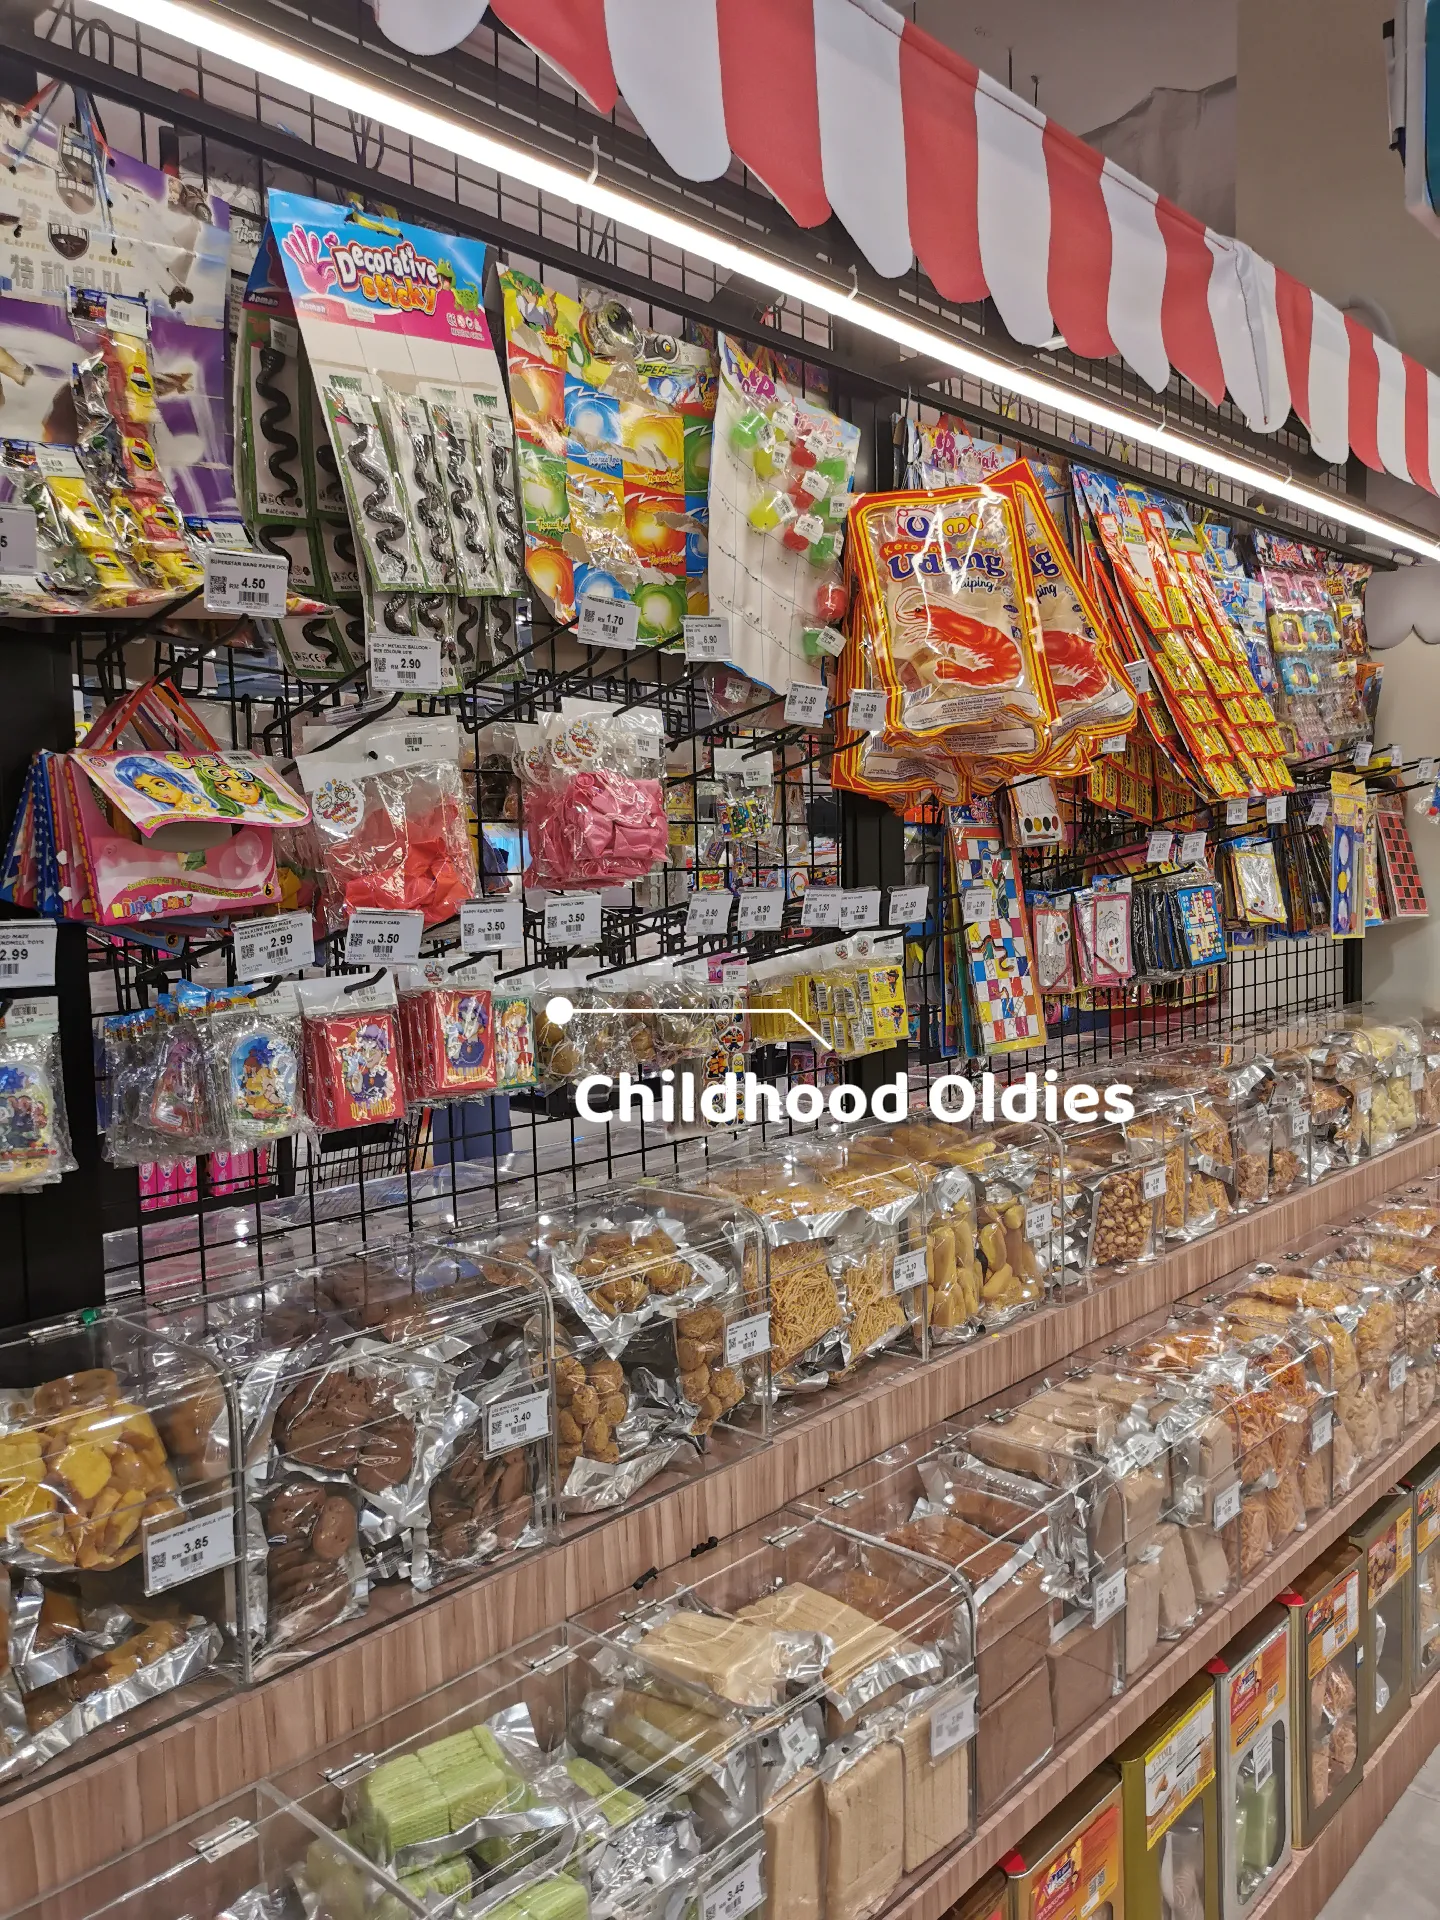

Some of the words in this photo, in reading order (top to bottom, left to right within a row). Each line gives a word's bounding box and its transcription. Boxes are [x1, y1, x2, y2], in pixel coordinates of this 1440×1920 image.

[332, 244, 440, 286] Decorative
[361, 275, 438, 316] sticky
[636, 364, 668, 374] UPER
[888, 552, 1006, 578] Udang
[241, 577, 266, 590] 4.50
[956, 575, 995, 593] aiping
[606, 614, 624, 626] 1.70
[703, 635, 718, 644] 6.90
[400, 658, 421, 669] 2.90
[804, 696, 816, 705] 2.50
[705, 909, 719, 917] 9.90
[756, 905, 771, 914] 9.90
[818, 903, 830, 912] 1.50
[855, 904, 868, 913] 2.99
[568, 913, 585, 923] 3.50
[486, 922, 505, 932] 3.50
[270, 934, 293, 948] 2.99
[377, 933, 400, 944] 3.50
[0, 948, 28, 961] 2.99
[514, 1411, 532, 1424] 3.40
[184, 1536, 209, 1554] 3.85
[727, 1881, 745, 1901] 3.45
